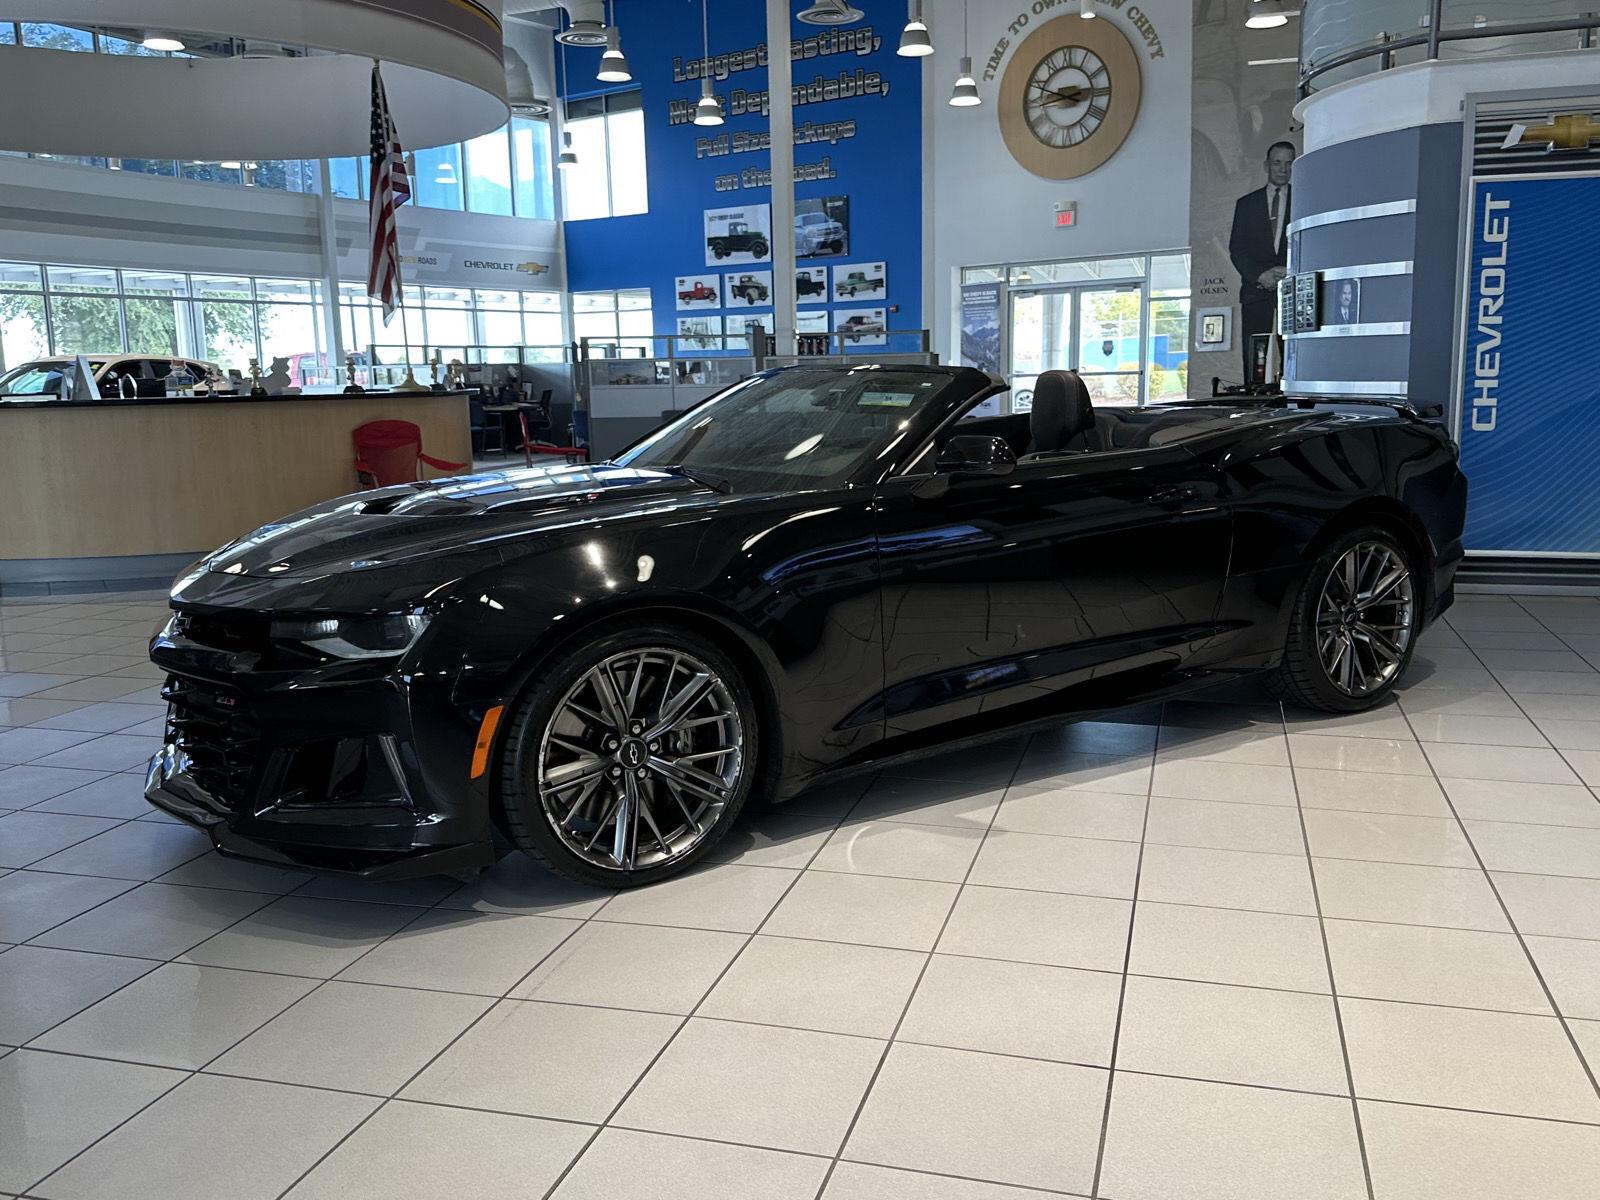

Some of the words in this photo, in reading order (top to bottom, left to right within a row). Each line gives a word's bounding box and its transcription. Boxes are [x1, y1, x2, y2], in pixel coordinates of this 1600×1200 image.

[672, 42, 768, 83] Longest
[790, 26, 881, 61] asting,
[983, 37, 1010, 81] TIME
[1008, 13, 1029, 35] TO
[1126, 6, 1165, 60] CHEVY
[730, 68, 890, 119] Depndable,
[696, 133, 730, 160] Full
[732, 130, 772, 155] Size
[793, 119, 857, 146] ckups
[714, 173, 739, 192] on
[740, 165, 772, 189] the
[793, 156, 837, 183] oad.
[417, 256, 437, 265] ROADS
[464, 260, 514, 271] CHEVROLET
[1200, 286, 1229, 295] OLSEN
[1204, 277, 1225, 286] JACK
[1471, 192, 1511, 432] CHEVROLET
